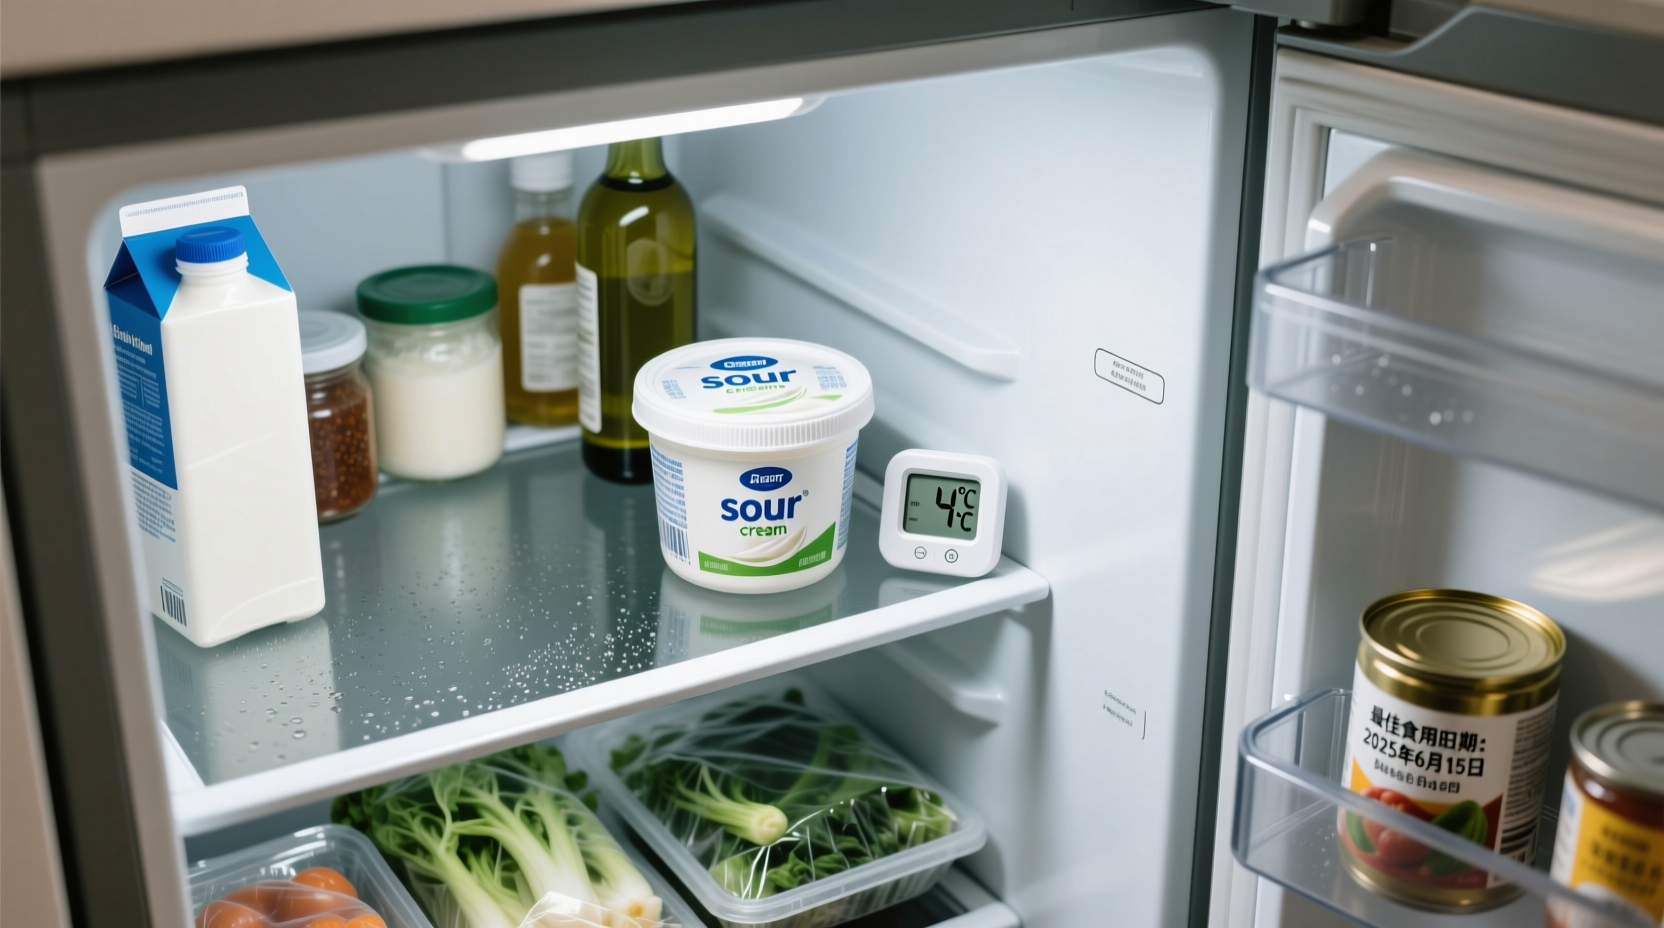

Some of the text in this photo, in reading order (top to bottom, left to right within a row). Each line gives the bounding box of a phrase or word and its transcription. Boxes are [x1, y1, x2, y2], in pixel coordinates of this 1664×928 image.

[701, 370, 797, 389] sour
[721, 494, 803, 523] sour
[740, 525, 787, 537] cream
[1363, 727, 1485, 777] 2025年6月15日
